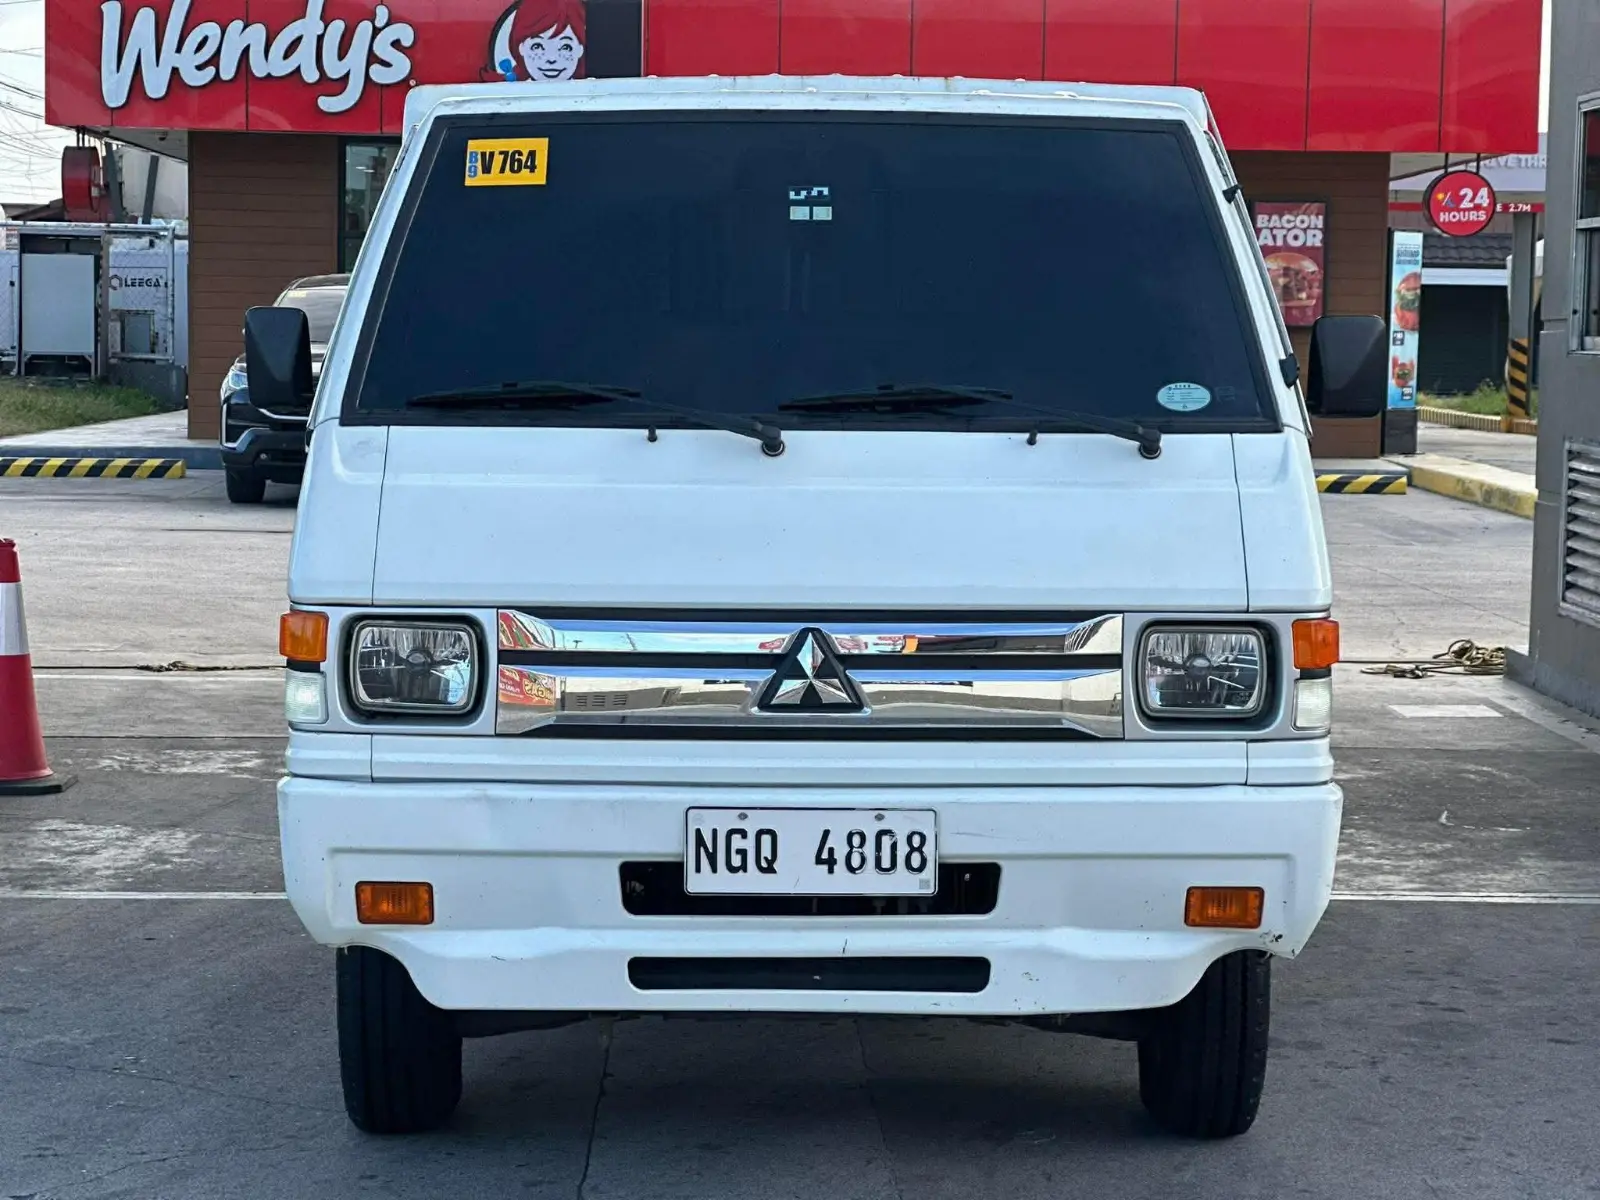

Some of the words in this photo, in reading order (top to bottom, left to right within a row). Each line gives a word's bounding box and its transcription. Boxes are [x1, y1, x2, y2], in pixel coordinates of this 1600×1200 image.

[100, 0, 415, 113] Wendy's
[498, 149, 538, 174] 764
[1459, 187, 1490, 209] 24
[1508, 203, 1531, 212] 2.7M
[1256, 213, 1324, 228] BACON
[1440, 211, 1487, 222] HOURS
[1259, 228, 1323, 247] ATOR
[124, 277, 162, 288] LEEGA
[694, 828, 778, 875] NGQ
[815, 828, 928, 875] 4808
